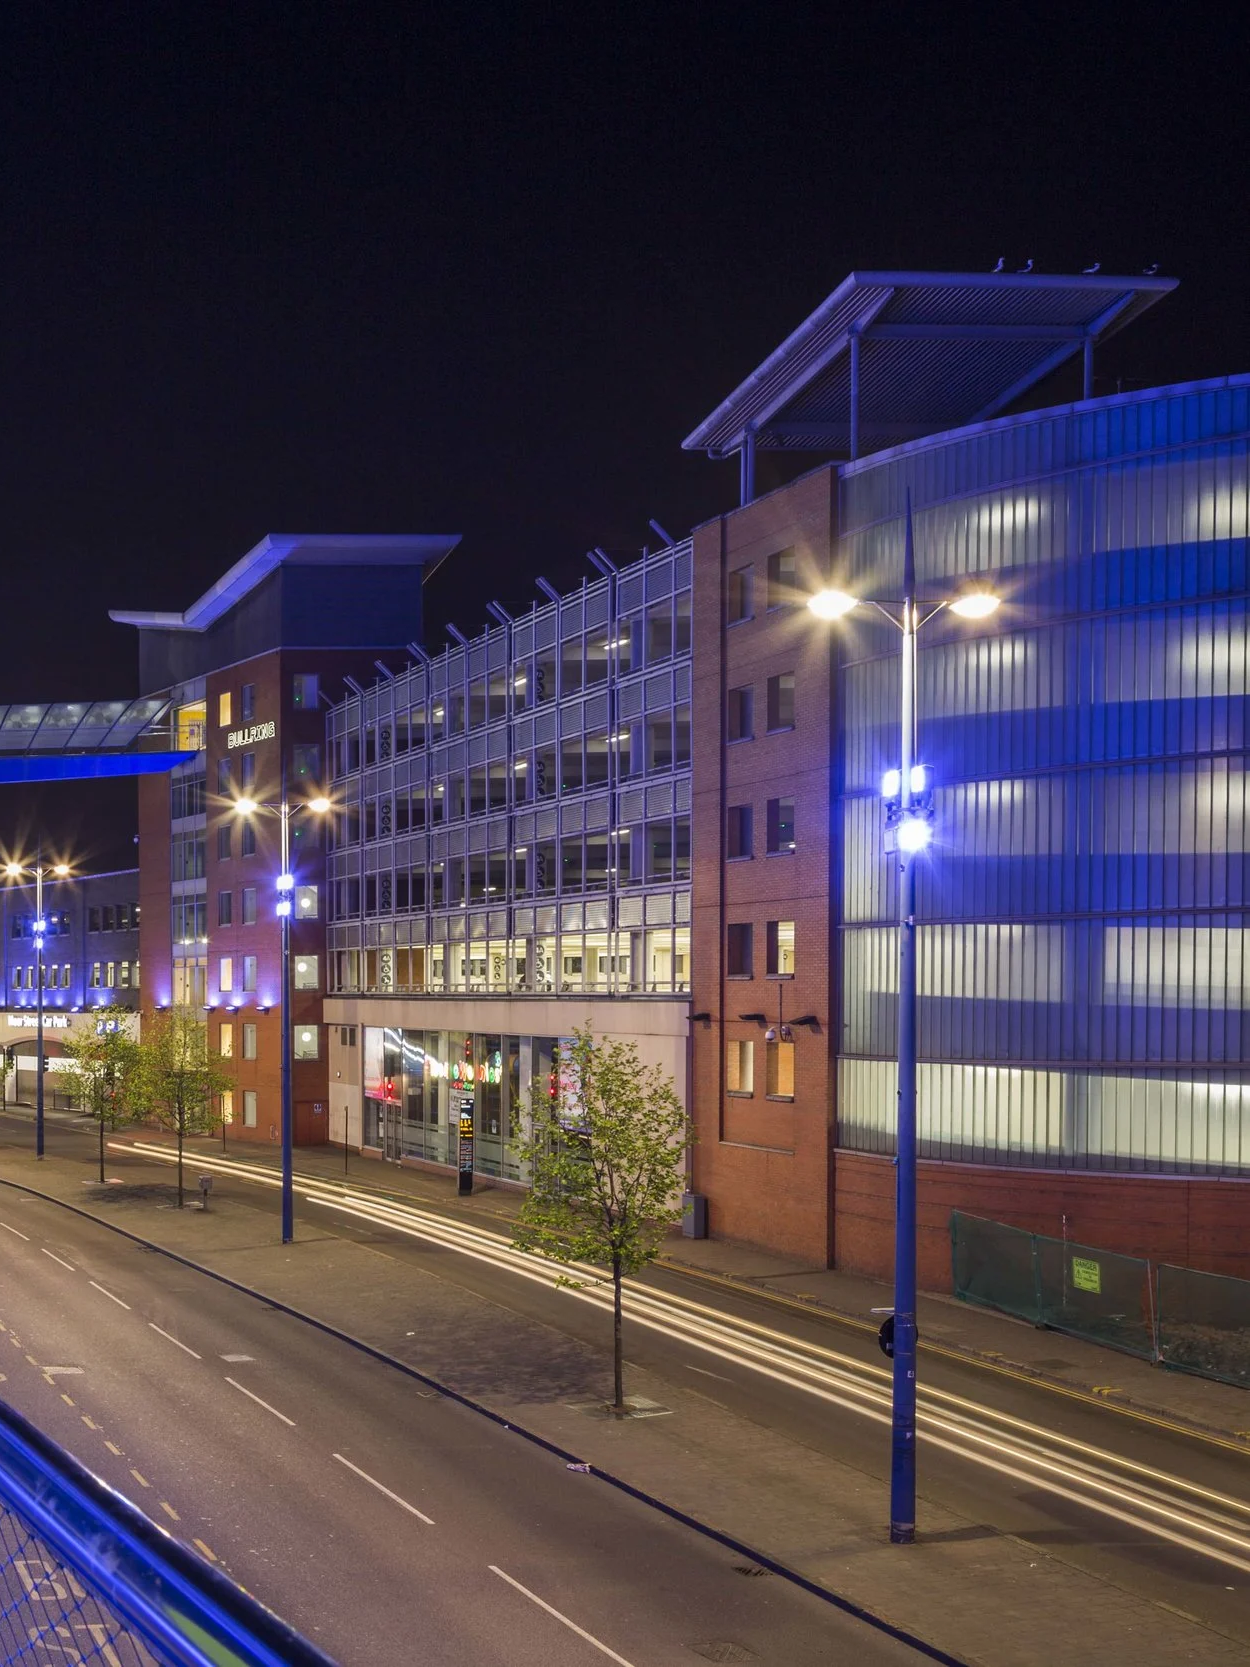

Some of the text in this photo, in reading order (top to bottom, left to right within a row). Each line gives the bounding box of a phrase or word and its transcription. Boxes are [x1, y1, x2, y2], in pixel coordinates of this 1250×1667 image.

[227, 721, 276, 749] BULLRING
[23, 1014, 41, 1027] Stree
[53, 1015, 68, 1028] Park
[1075, 1259, 1099, 1272] DANGER
